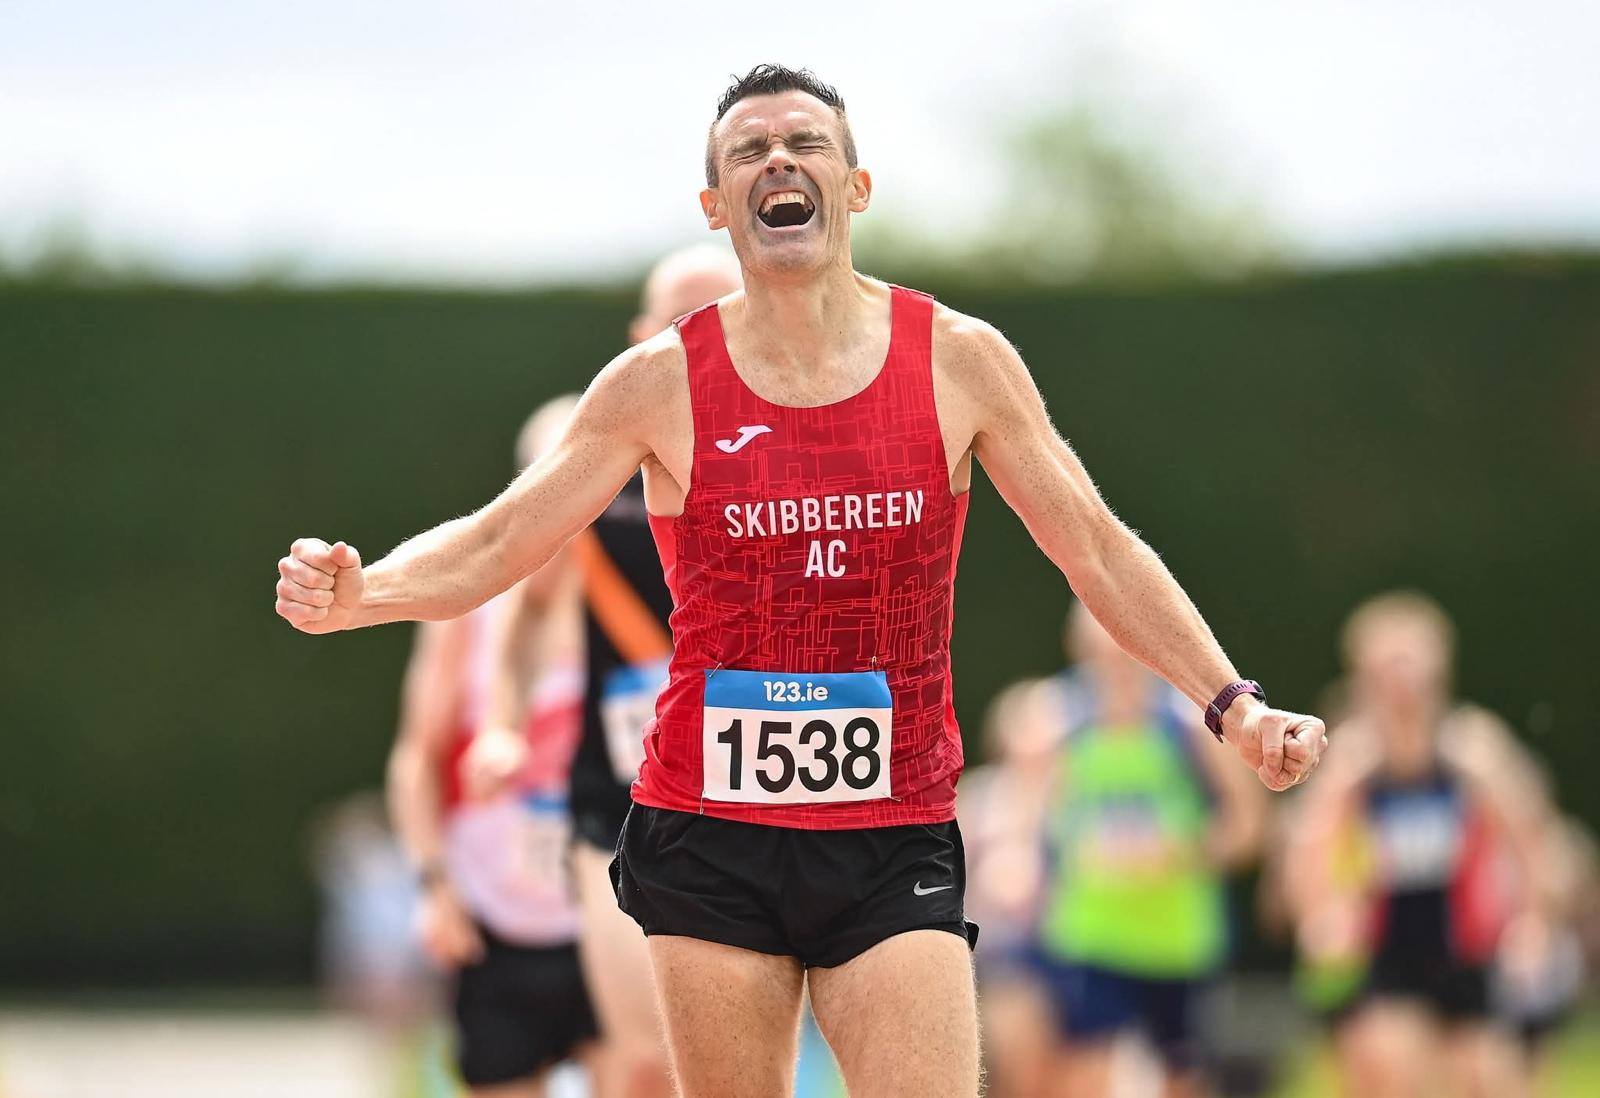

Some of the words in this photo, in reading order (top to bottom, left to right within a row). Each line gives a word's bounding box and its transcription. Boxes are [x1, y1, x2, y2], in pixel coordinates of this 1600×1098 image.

[724, 490, 925, 539] SKIBBEREEN
[804, 539, 847, 578] AC
[763, 681, 829, 703] 123.ie
[717, 717, 881, 793] 1538
